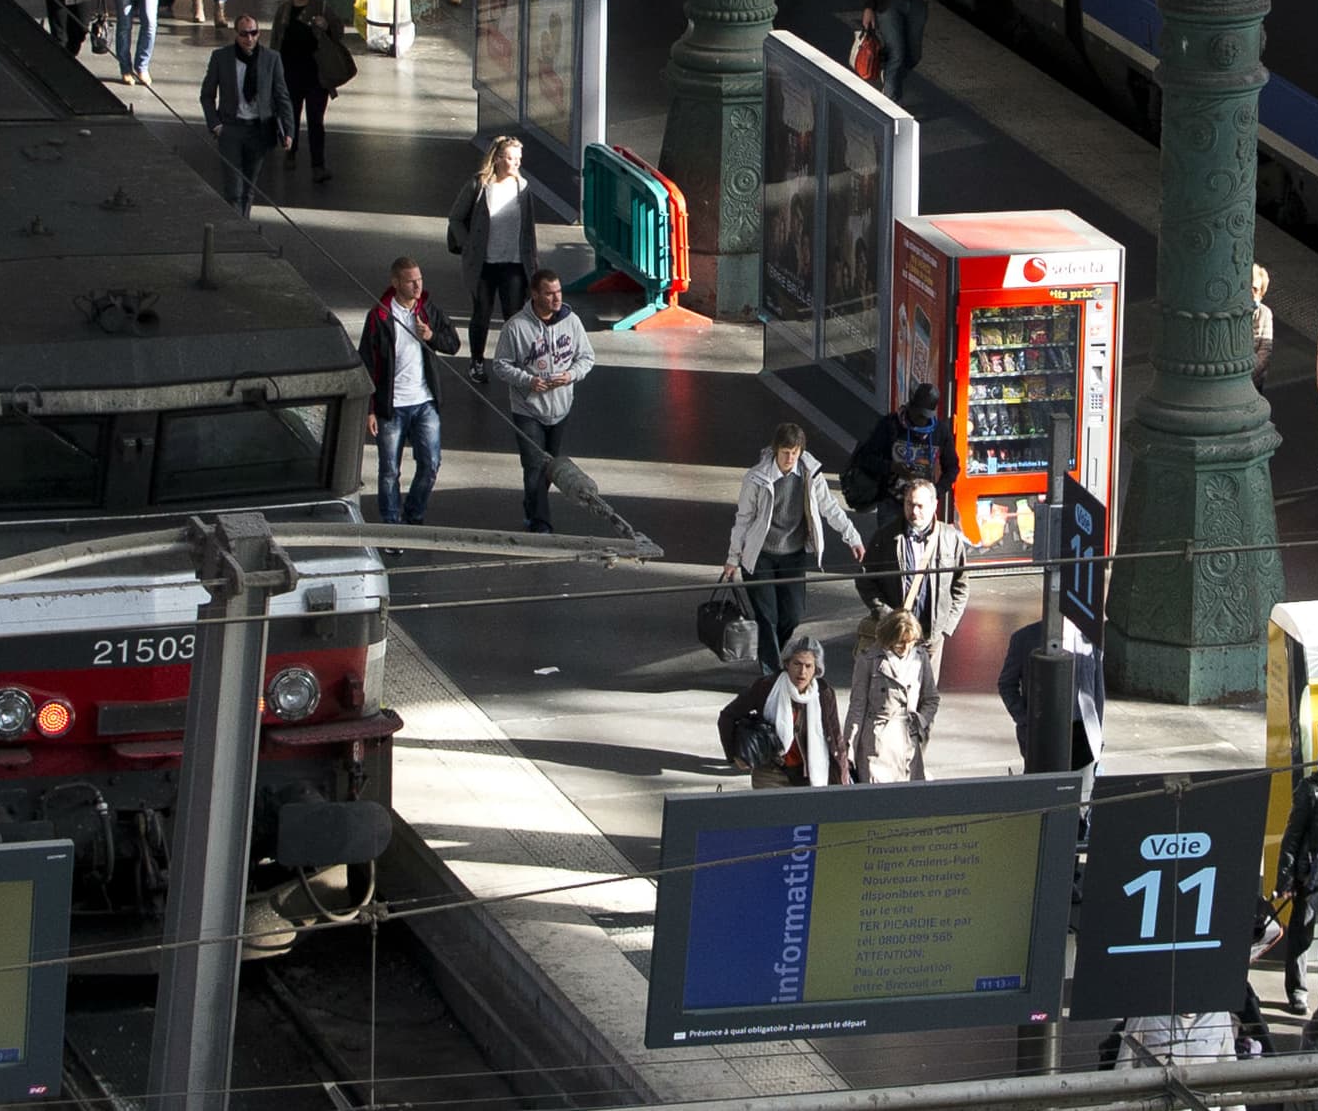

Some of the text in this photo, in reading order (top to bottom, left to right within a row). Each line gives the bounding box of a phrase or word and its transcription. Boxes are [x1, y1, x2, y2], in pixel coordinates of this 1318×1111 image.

[1070, 534, 1094, 606] 11
[93, 635, 195, 665] 21503
[867, 841, 979, 856] Travaux en cours sur
[1151, 837, 1201, 856] Voie
[864, 855, 980, 873] la ligne Amiens-Paris
[863, 872, 966, 886] Nouveaux horaires
[861, 889, 925, 902] disponibles
[928, 890, 942, 898] en
[1122, 866, 1217, 939] 11
[770, 823, 812, 1003] information
[860, 906, 914, 917] sur le site
[859, 917, 973, 931] TER PICARDIE et par
[878, 935, 908, 946] 0800
[855, 963, 952, 977] Pas de circulation
[689, 1019, 867, 1038] Présence à quai obligatoire 2 min avant le départ
